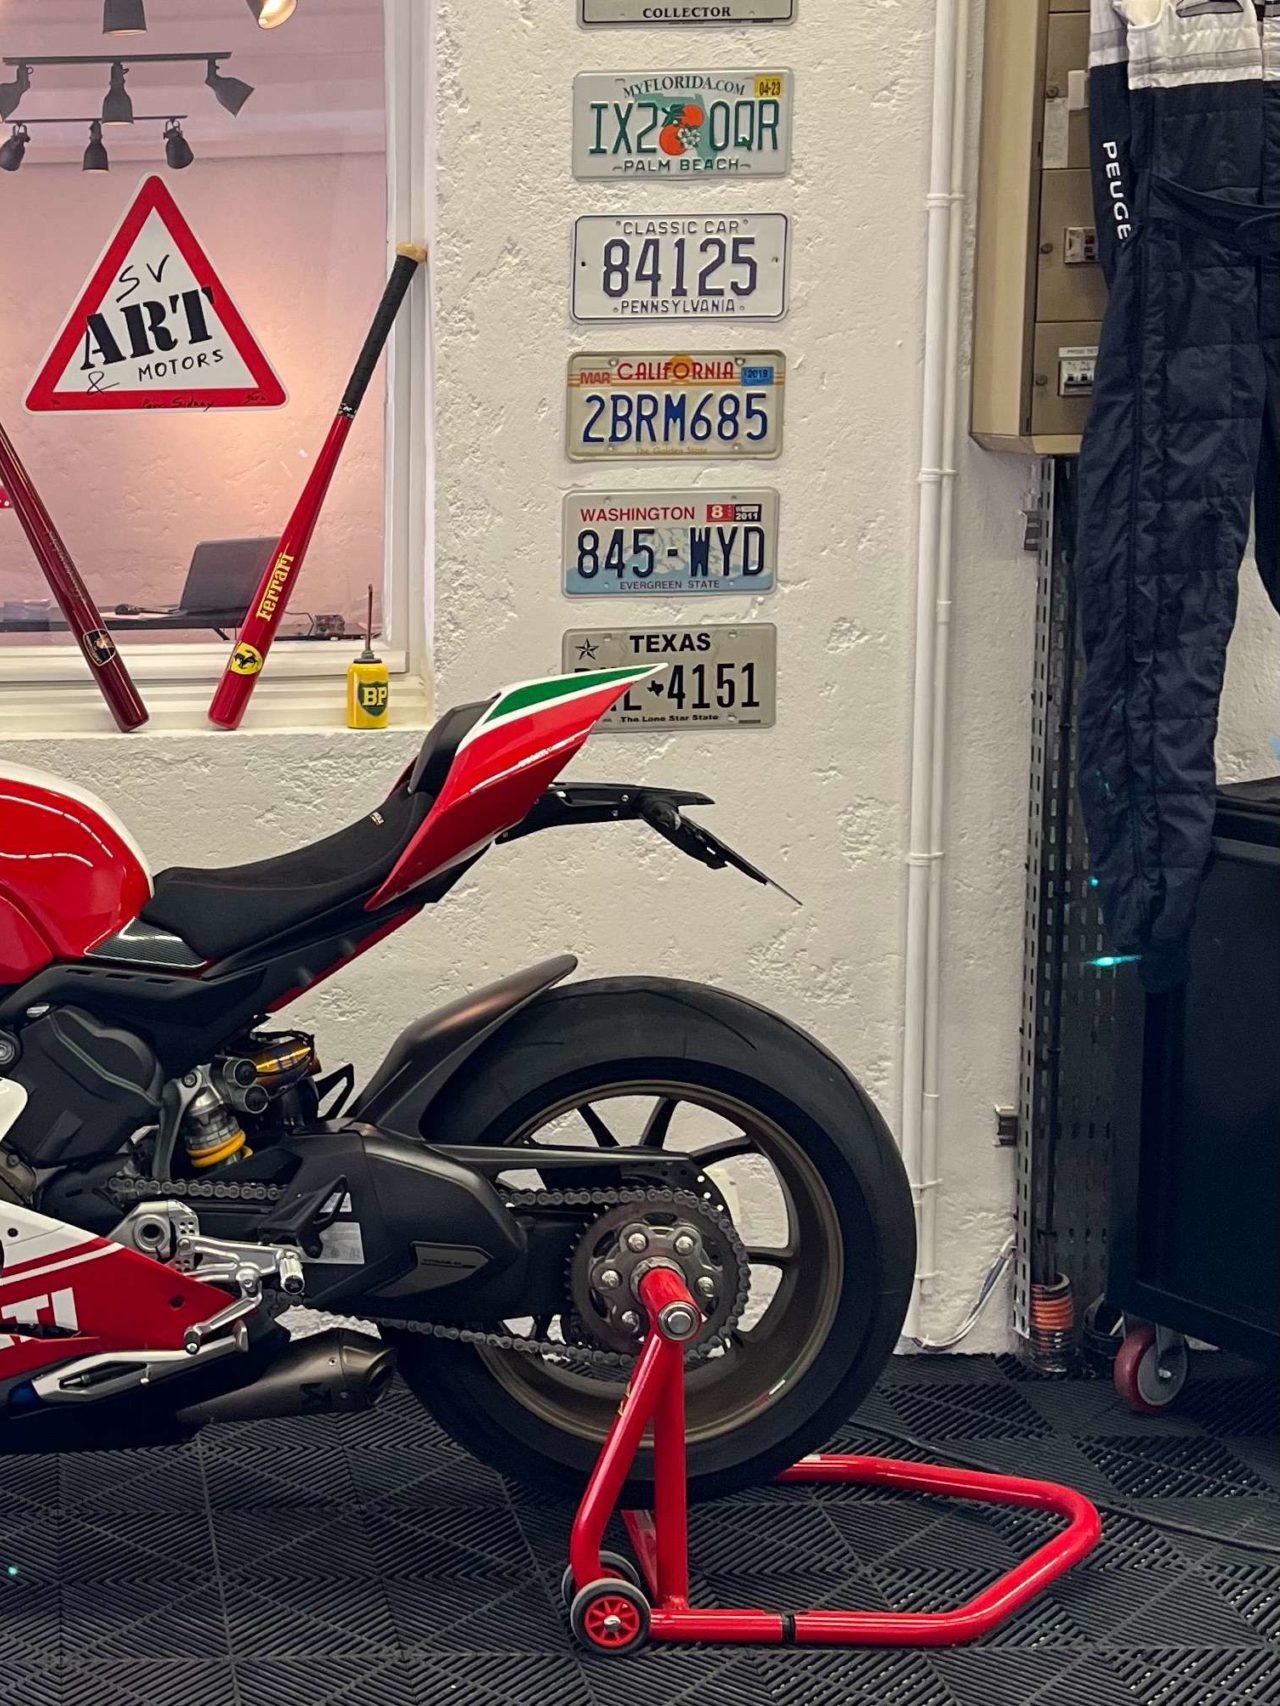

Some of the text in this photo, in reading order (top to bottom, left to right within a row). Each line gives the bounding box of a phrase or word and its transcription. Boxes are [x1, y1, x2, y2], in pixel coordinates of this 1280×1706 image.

[642, 6, 731, 19] COLLECTOR
[623, 75, 745, 99] MYFLORIDA.COM
[759, 82, 781, 96] 04-23
[623, 158, 739, 172] PALM BEACH
[623, 219, 740, 235] CLASSIC CAR
[602, 237, 758, 298] 84125
[621, 299, 736, 314] PENNSYLVANIA
[80, 286, 215, 370] ART
[86, 349, 224, 395] & MOTORS
[580, 372, 611, 384] MAR
[617, 361, 734, 382] CALIFORNIA
[582, 391, 768, 443] 2BRM685
[580, 507, 695, 522] WASHINGTON
[711, 505, 724, 519] 8
[735, 513, 758, 521] 2011
[577, 526, 765, 579] 845-WYD
[256, 552, 295, 622] Ferrari
[620, 579, 720, 590] EVERGREEN STATE
[630, 632, 711, 653] TEXAS
[362, 686, 388, 706] BP
[667, 662, 760, 710] 4151
